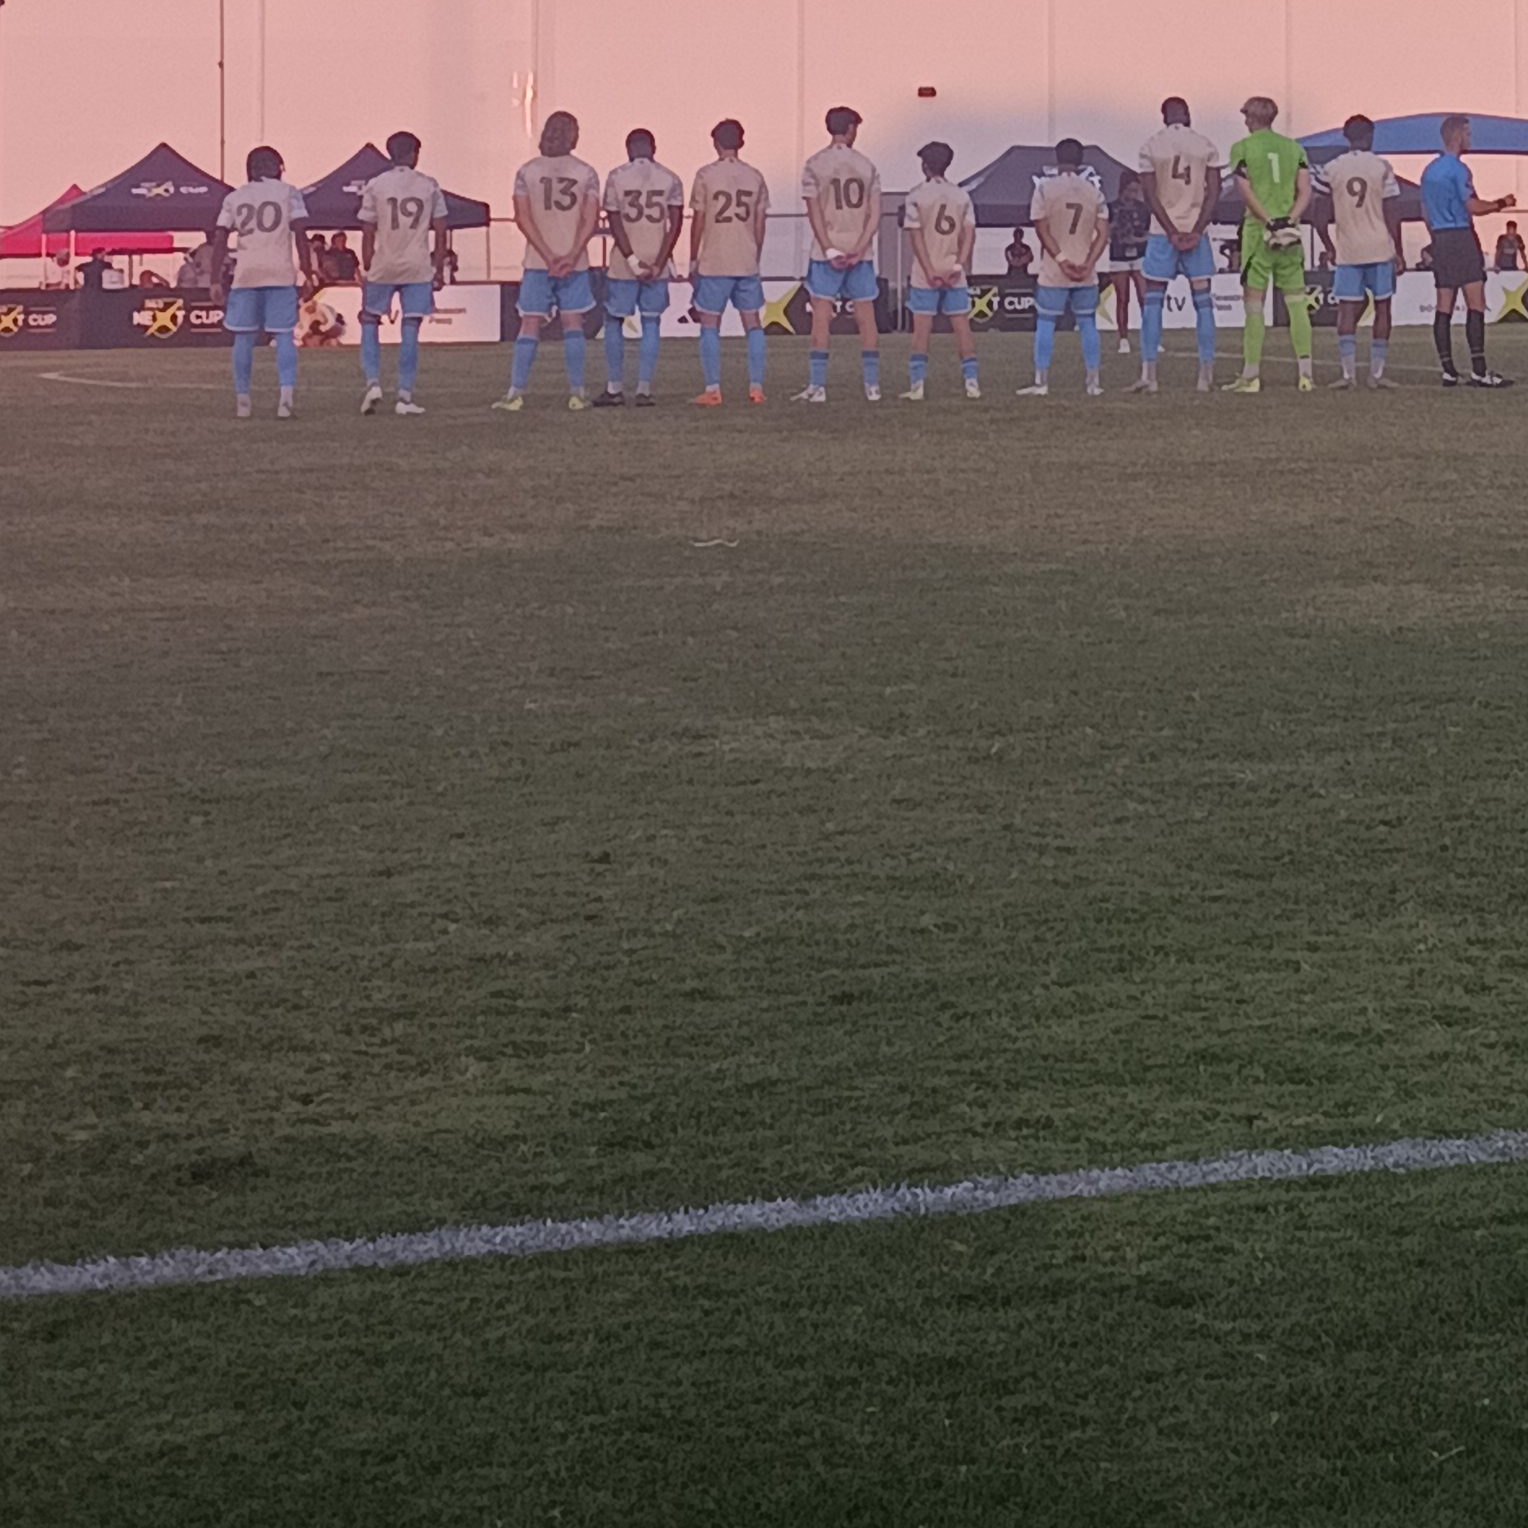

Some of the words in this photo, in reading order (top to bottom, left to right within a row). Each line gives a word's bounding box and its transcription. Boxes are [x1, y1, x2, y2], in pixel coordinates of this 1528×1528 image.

[1171, 154, 1192, 186] 4
[1266, 152, 1281, 184] 1
[539, 176, 579, 212] 13
[622, 189, 665, 224] 35
[712, 189, 754, 224] 25
[830, 177, 865, 210] 10
[1346, 176, 1368, 209] 9
[236, 200, 282, 238] 20
[386, 196, 425, 231] 19
[934, 203, 957, 236] 6
[1065, 202, 1084, 235] 7
[190, 310, 224, 325] CUP
